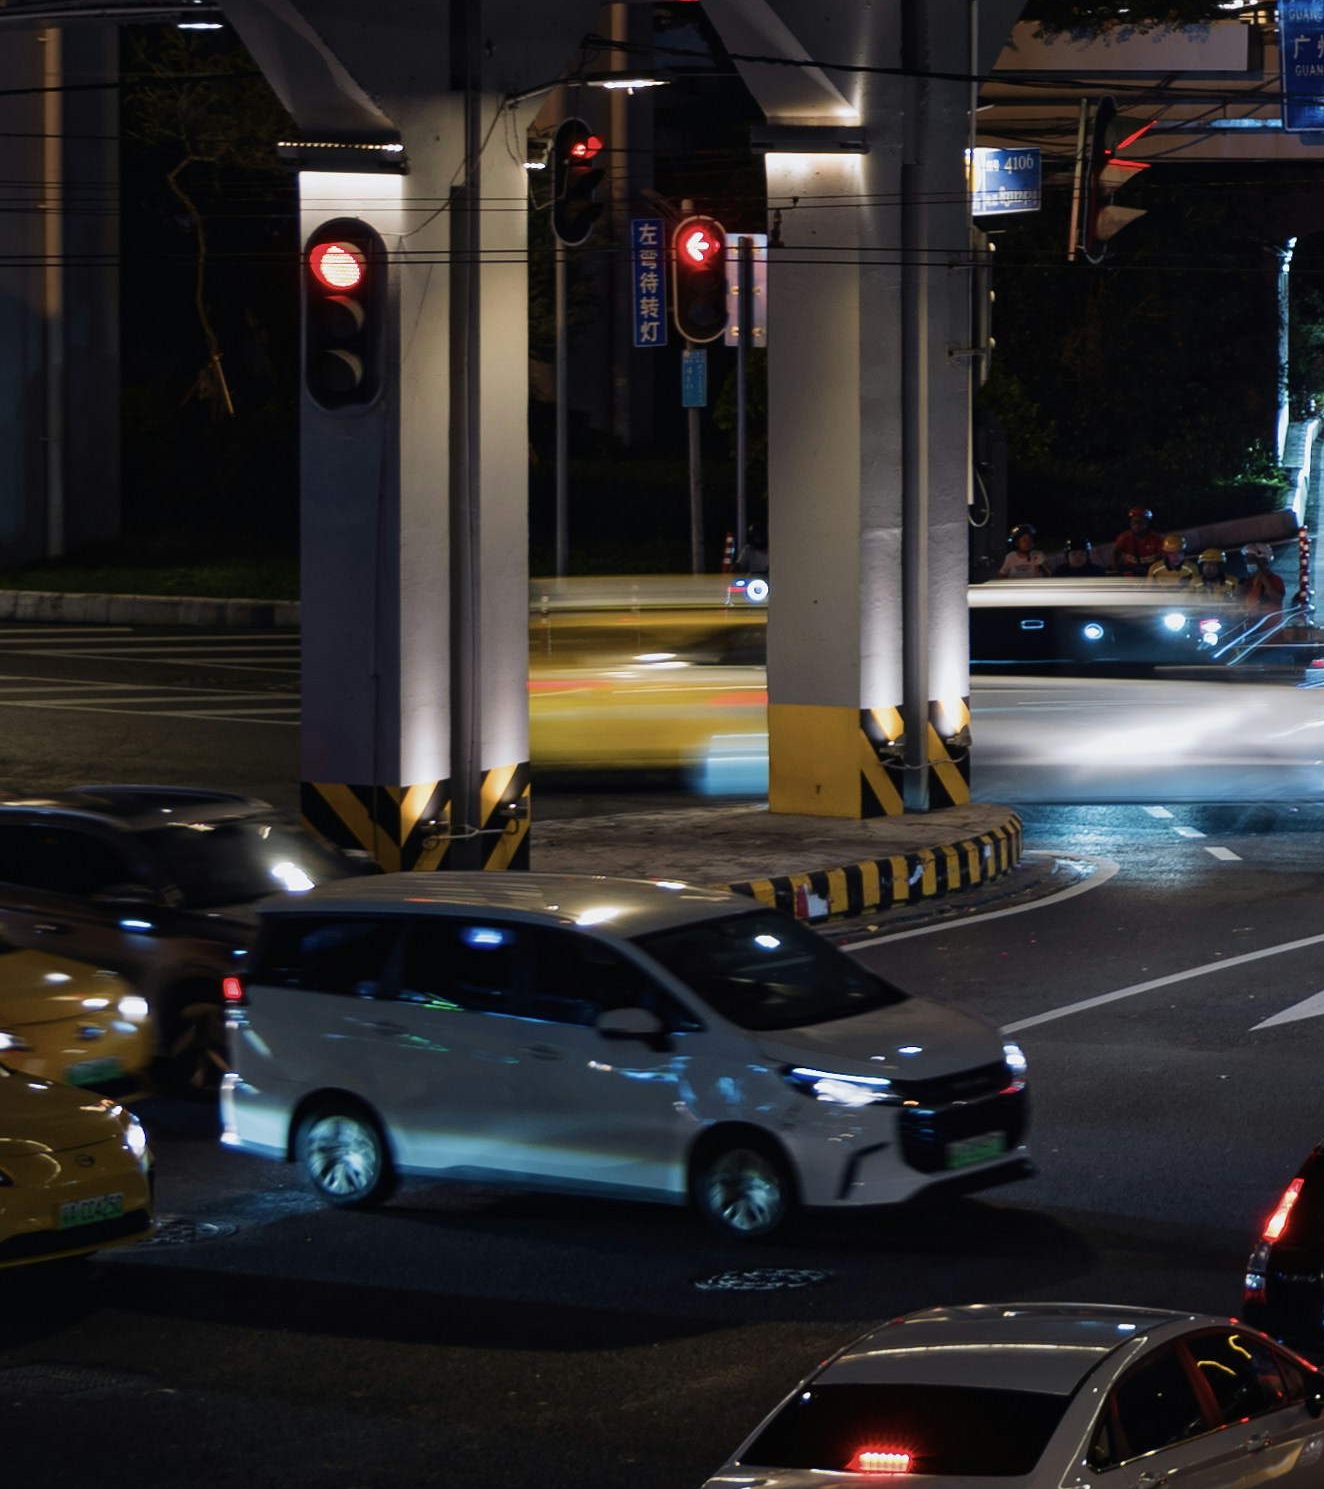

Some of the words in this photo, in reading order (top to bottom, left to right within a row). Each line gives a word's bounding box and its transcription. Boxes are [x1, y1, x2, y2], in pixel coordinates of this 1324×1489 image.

[1289, 7, 1324, 20] GUANG
[638, 223, 661, 343] 左弯待转灯
